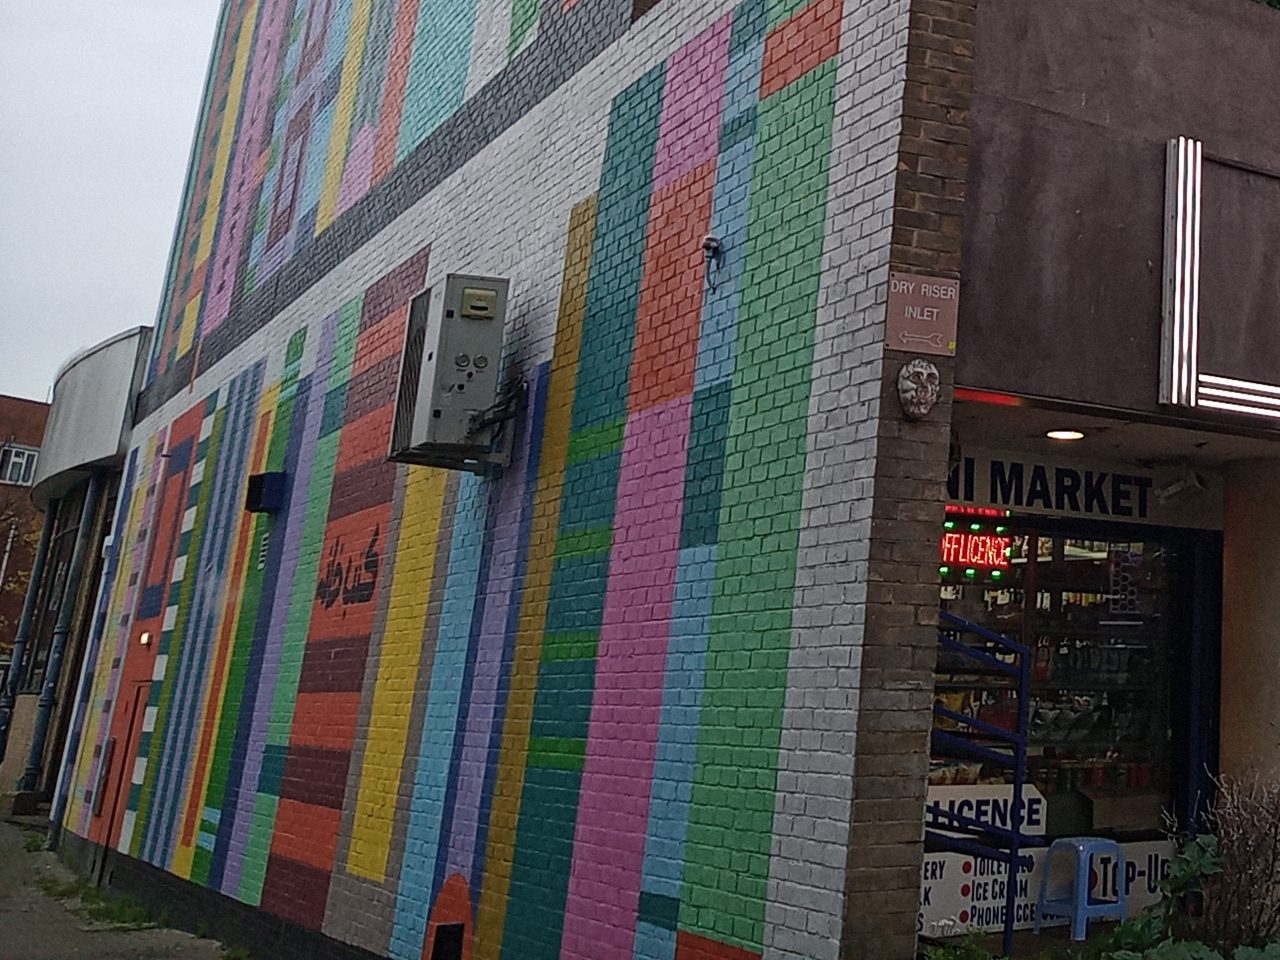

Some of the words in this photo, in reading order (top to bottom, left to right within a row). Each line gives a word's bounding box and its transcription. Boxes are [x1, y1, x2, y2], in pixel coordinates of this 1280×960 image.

[891, 280, 915, 294] DRY
[921, 284, 956, 300] RISER
[904, 305, 940, 322] INLET
[990, 460, 1152, 518] MARKET
[971, 880, 988, 902] ICE
[971, 905, 1007, 926] PHONE
